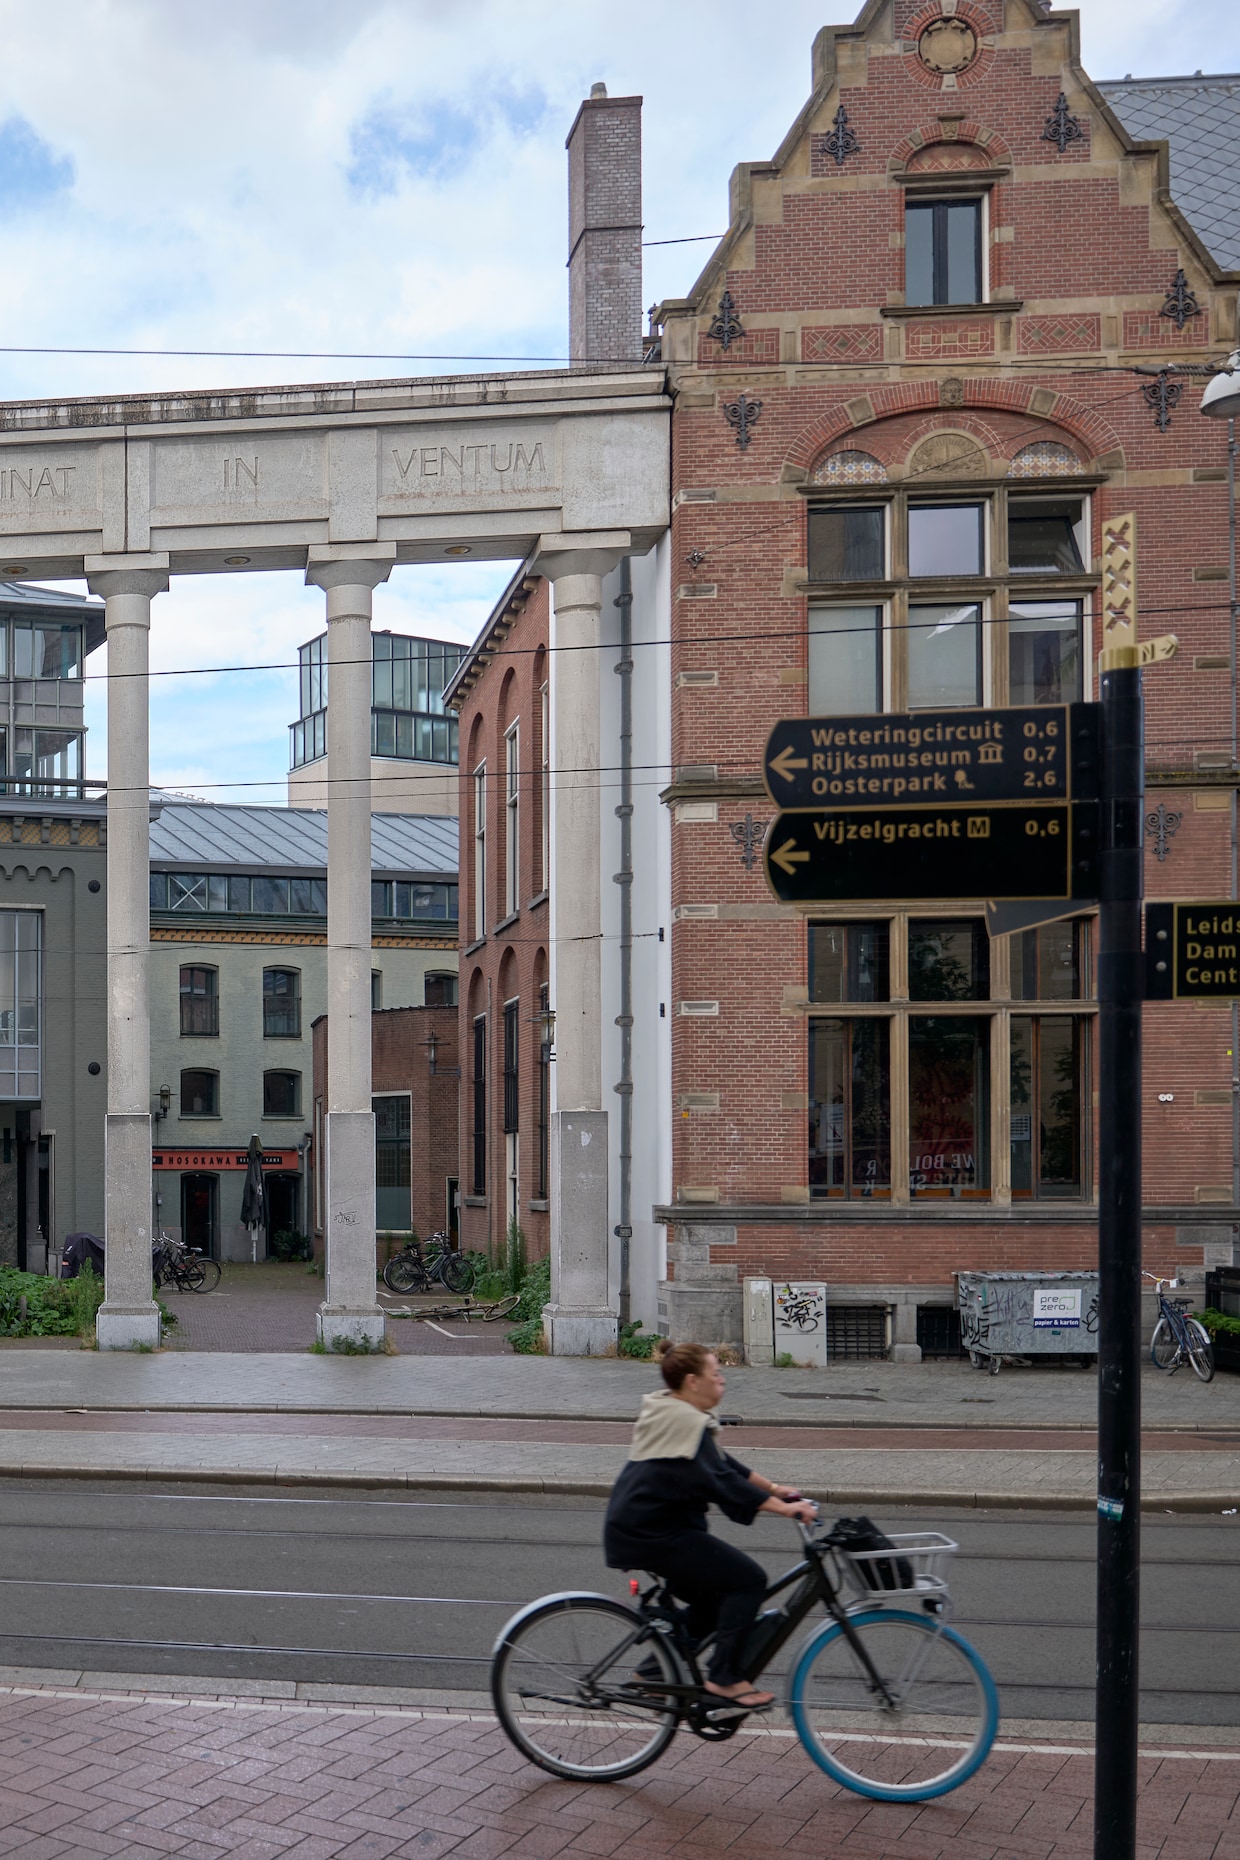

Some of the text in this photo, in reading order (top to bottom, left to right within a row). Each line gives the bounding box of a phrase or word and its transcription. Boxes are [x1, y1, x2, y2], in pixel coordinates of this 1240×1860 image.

[223, 456, 260, 487] IN
[392, 442, 547, 479] VENTUM
[810, 719, 1058, 747] Weteringcircuit 0,6
[811, 745, 1057, 775] Rijksmuseum 0,7
[811, 770, 1057, 797] Oosterpark 2,6
[813, 818, 962, 845] Vijzelgracht
[1025, 819, 1061, 838] 0,6
[1186, 942, 1237, 960] Dam
[1185, 966, 1240, 984] Cent
[169, 1156, 231, 1165] HOSOKAWA
[1040, 1296, 1059, 1305] pre
[1034, 1319, 1052, 1327] papier
